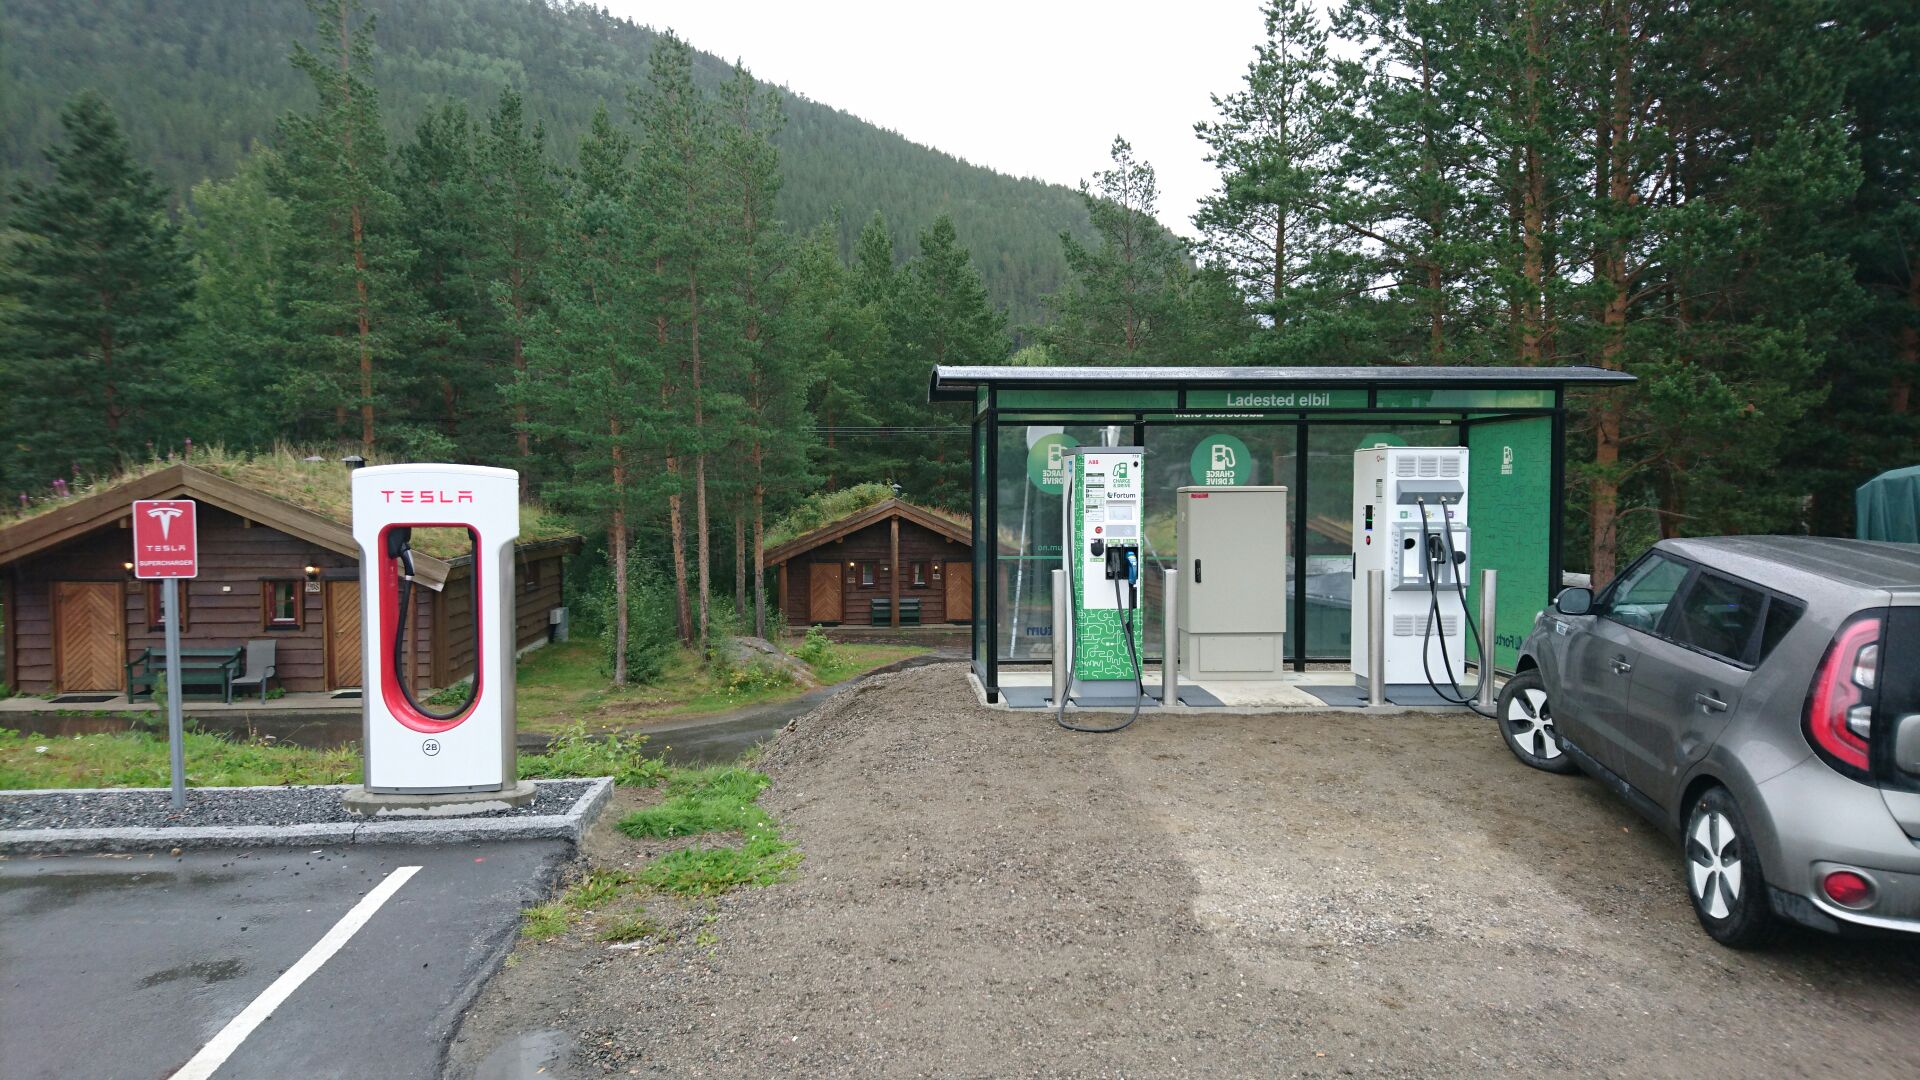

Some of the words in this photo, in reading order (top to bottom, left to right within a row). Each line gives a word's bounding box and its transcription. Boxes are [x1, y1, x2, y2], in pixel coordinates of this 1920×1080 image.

[1227, 393, 1294, 406] Ladested
[1299, 393, 1330, 406] elbil
[381, 490, 472, 503] TESLA
[425, 743, 438, 751] 2B
